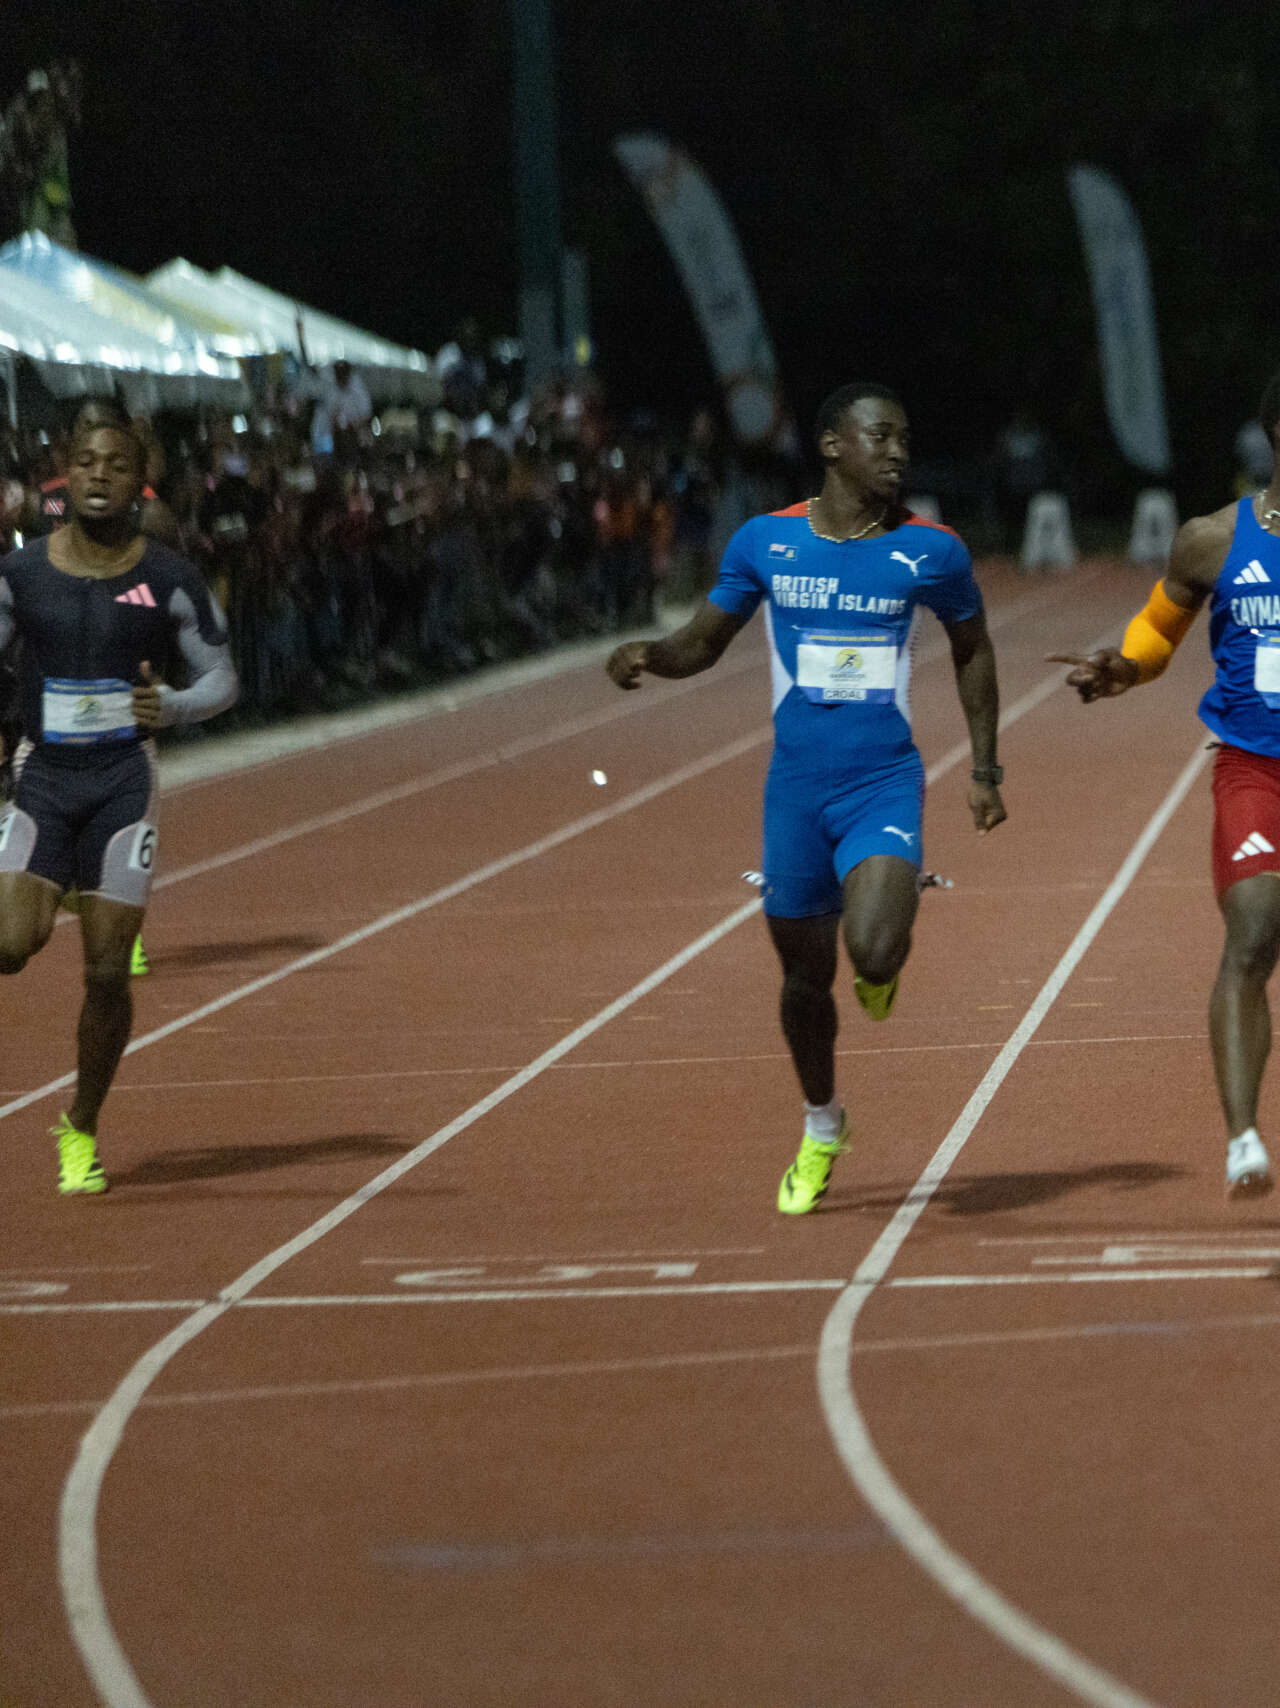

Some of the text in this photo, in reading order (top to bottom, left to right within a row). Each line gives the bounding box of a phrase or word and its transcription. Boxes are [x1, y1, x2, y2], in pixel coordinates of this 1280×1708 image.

[772, 574, 840, 594] BRITISH
[773, 591, 906, 615] VIRGIN ISLANDS
[823, 689, 864, 700] CROAL
[139, 828, 155, 869] 6
